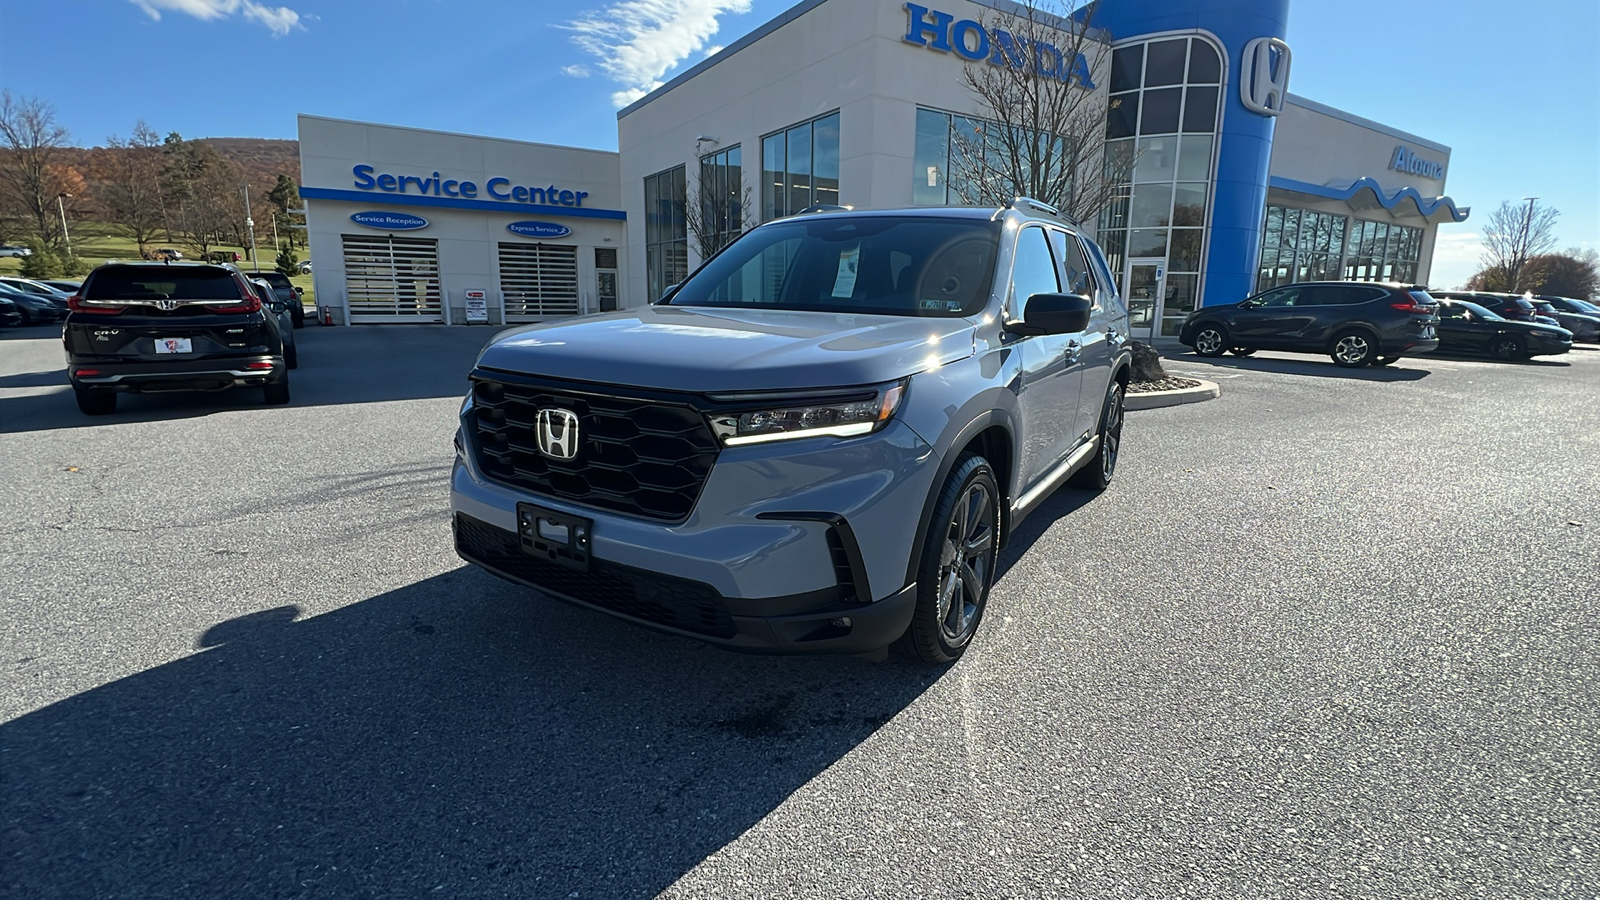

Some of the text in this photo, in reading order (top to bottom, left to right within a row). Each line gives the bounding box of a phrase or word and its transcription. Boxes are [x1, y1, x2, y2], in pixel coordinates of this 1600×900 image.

[901, 2, 1096, 90] HONDA
[353, 164, 589, 207] Service Center
[355, 214, 424, 226] Service Reception
[510, 224, 559, 234] Express Service
